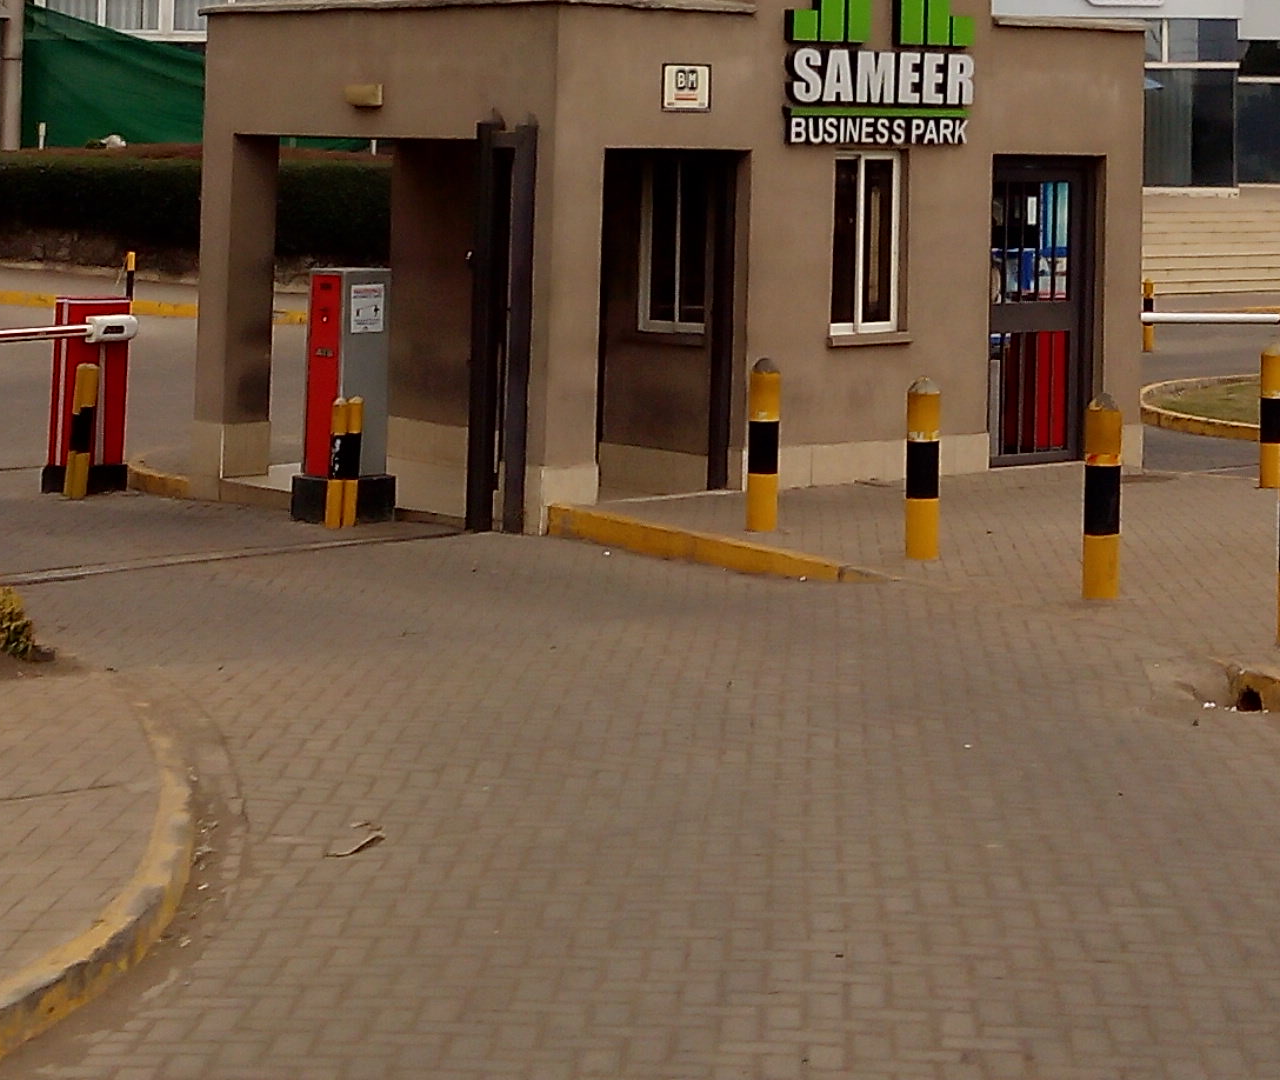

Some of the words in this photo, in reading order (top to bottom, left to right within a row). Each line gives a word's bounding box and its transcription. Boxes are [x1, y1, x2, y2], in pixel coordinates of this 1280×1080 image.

[792, 47, 975, 105] SAMEER
[790, 118, 906, 143] BUSINESS
[911, 119, 968, 144] PARK
